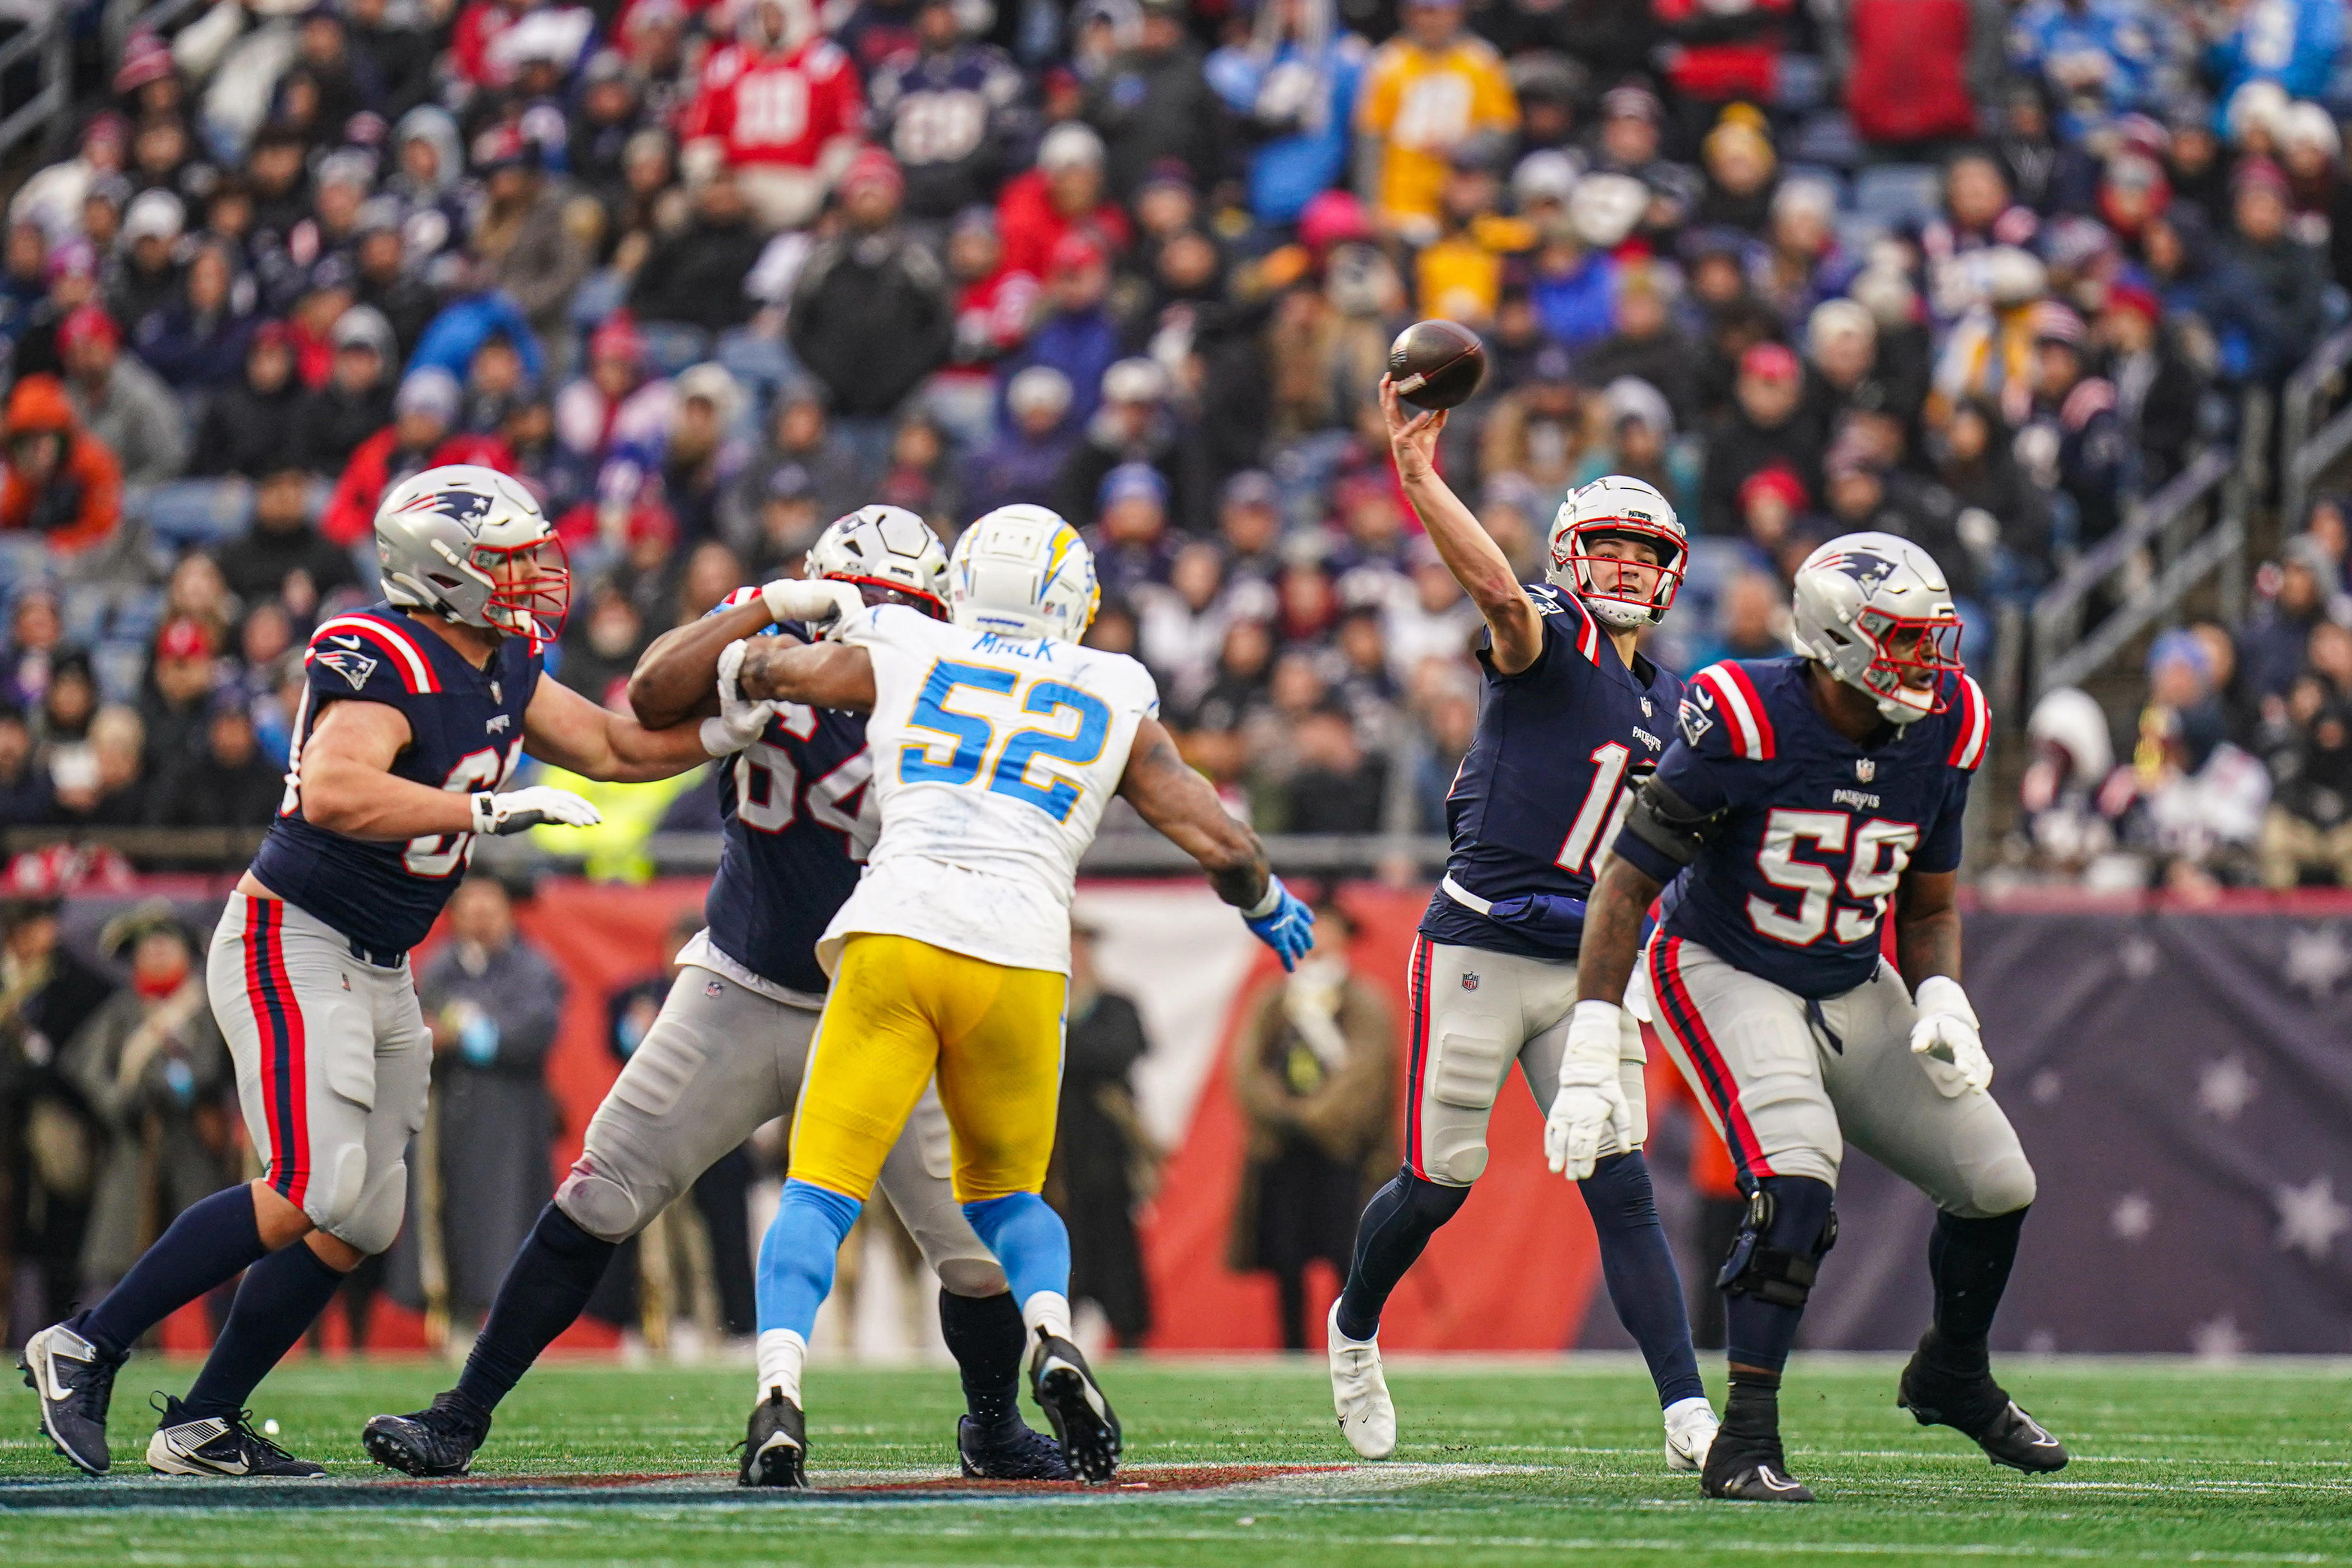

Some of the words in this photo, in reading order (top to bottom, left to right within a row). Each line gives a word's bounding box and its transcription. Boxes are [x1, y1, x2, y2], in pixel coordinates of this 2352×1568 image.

[733, 699, 882, 866] 64
[898, 657, 1112, 824] 52
[1632, 726, 1661, 752] PATRIOTS
[1745, 807, 1920, 946] 59
[1464, 980, 1476, 989] NFL
